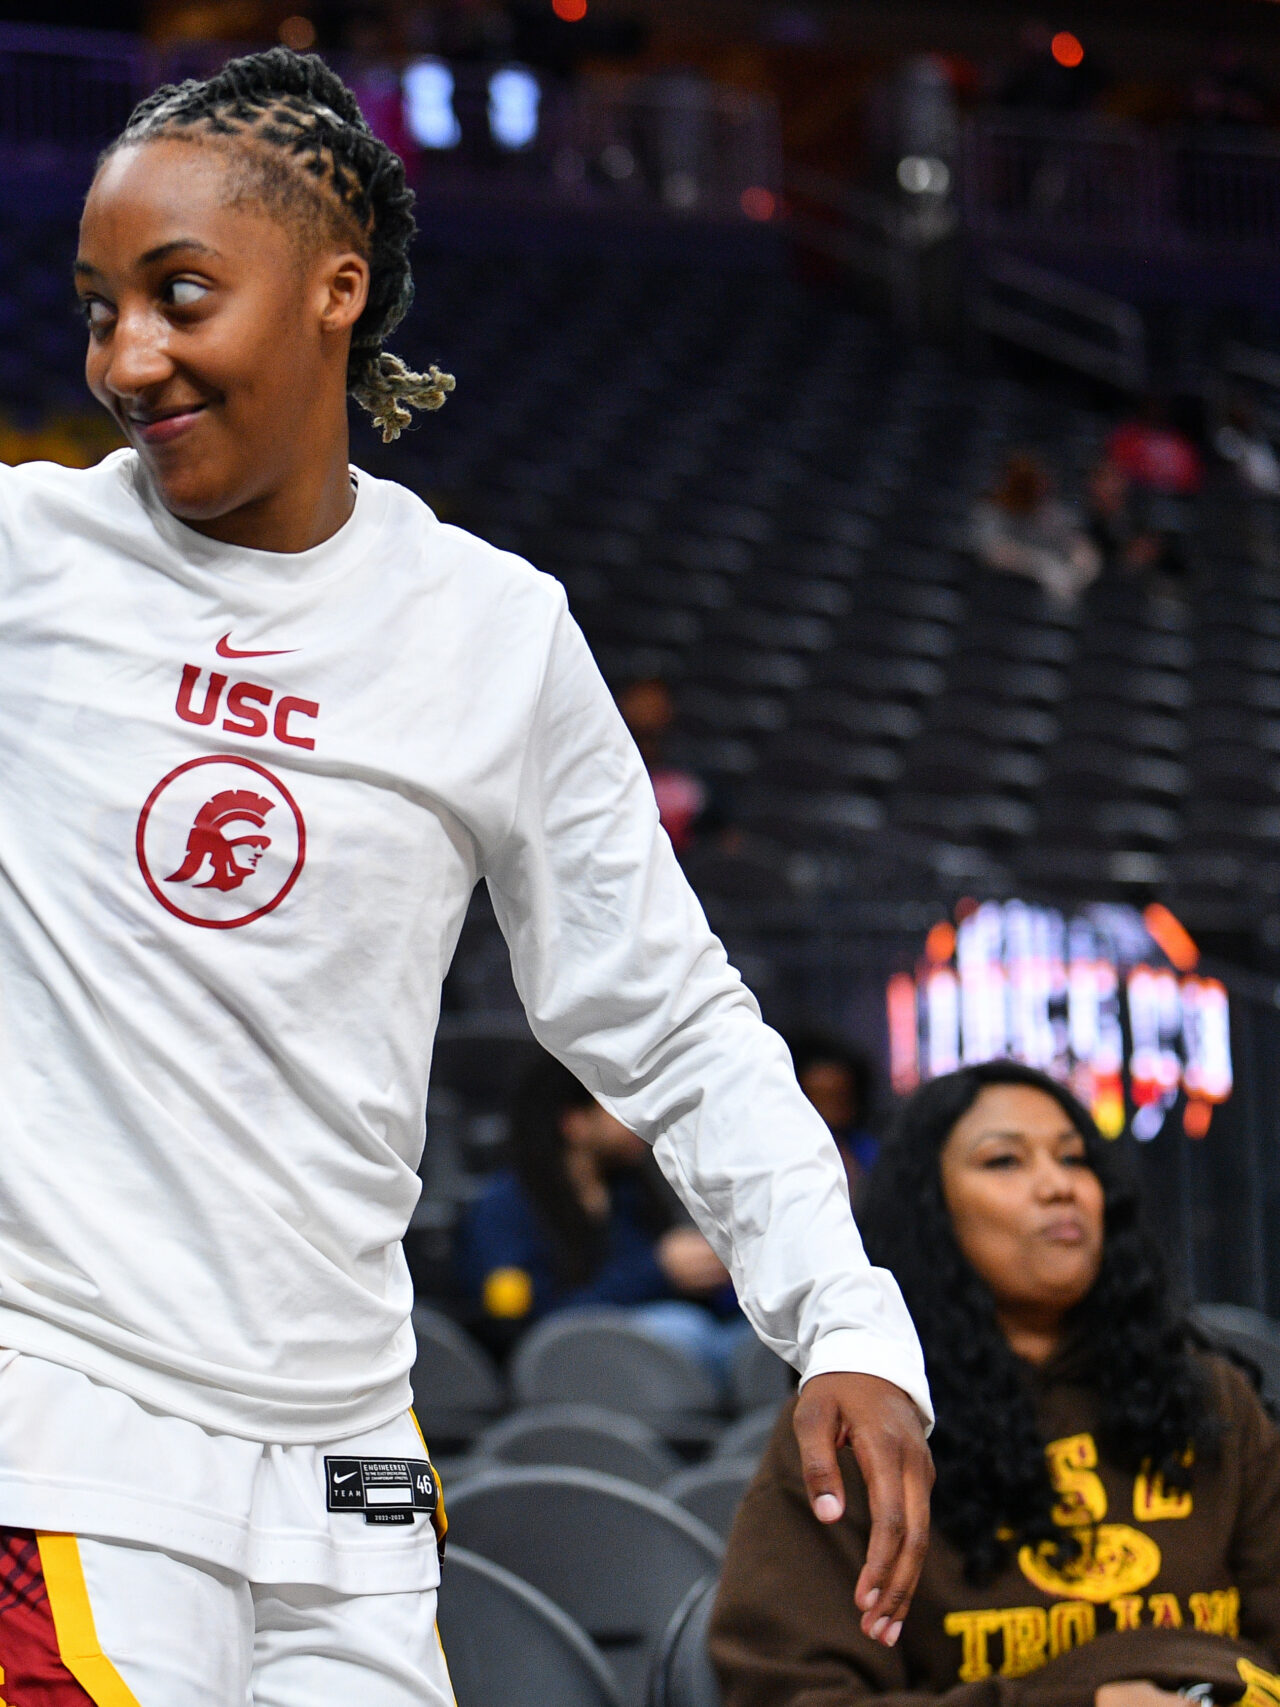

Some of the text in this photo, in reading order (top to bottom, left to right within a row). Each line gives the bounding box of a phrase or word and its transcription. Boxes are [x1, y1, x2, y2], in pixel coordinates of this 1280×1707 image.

[175, 663, 319, 751] USC
[363, 1463, 407, 1471] ENGINEERED
[416, 1474, 432, 1495] 46
[333, 1489, 361, 1498] TEAM
